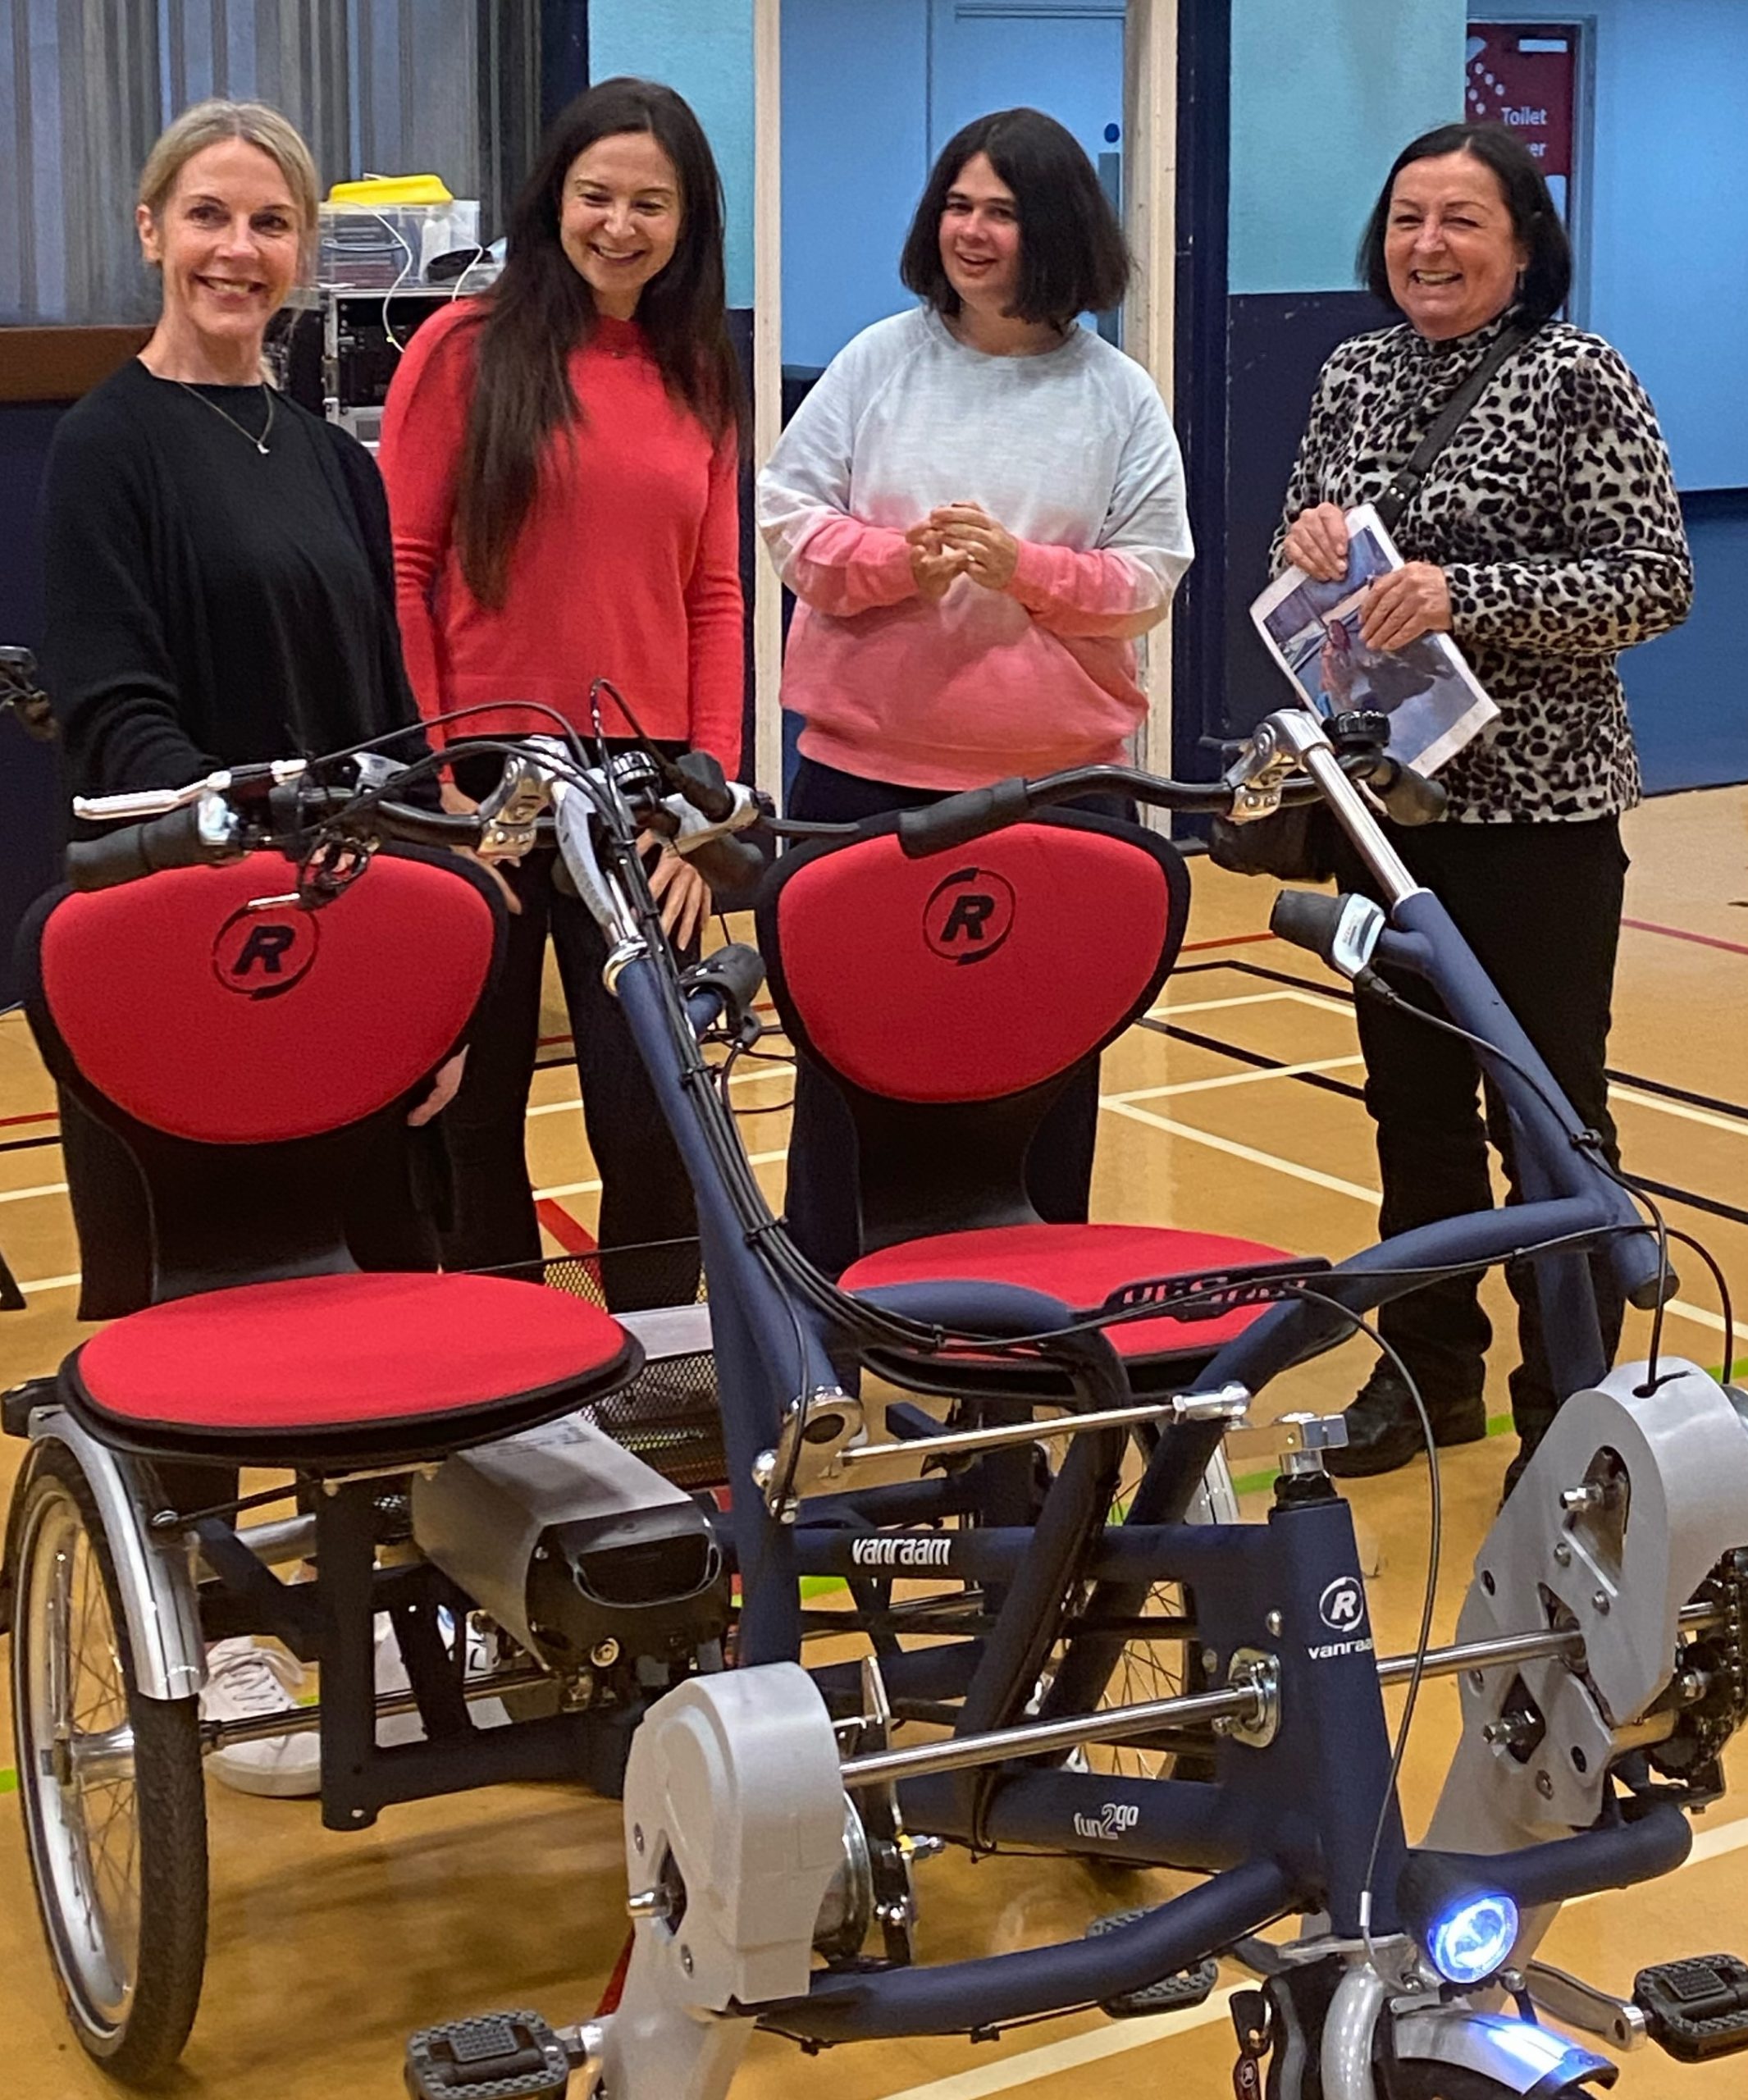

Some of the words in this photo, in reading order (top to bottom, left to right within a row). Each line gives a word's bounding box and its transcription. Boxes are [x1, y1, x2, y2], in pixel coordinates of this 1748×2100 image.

[1500, 106, 1548, 126] Toilet
[851, 1537, 952, 1566] vanraam
[1308, 1637, 1373, 1659] vanraa
[1073, 1802, 1139, 1840] fun2go
